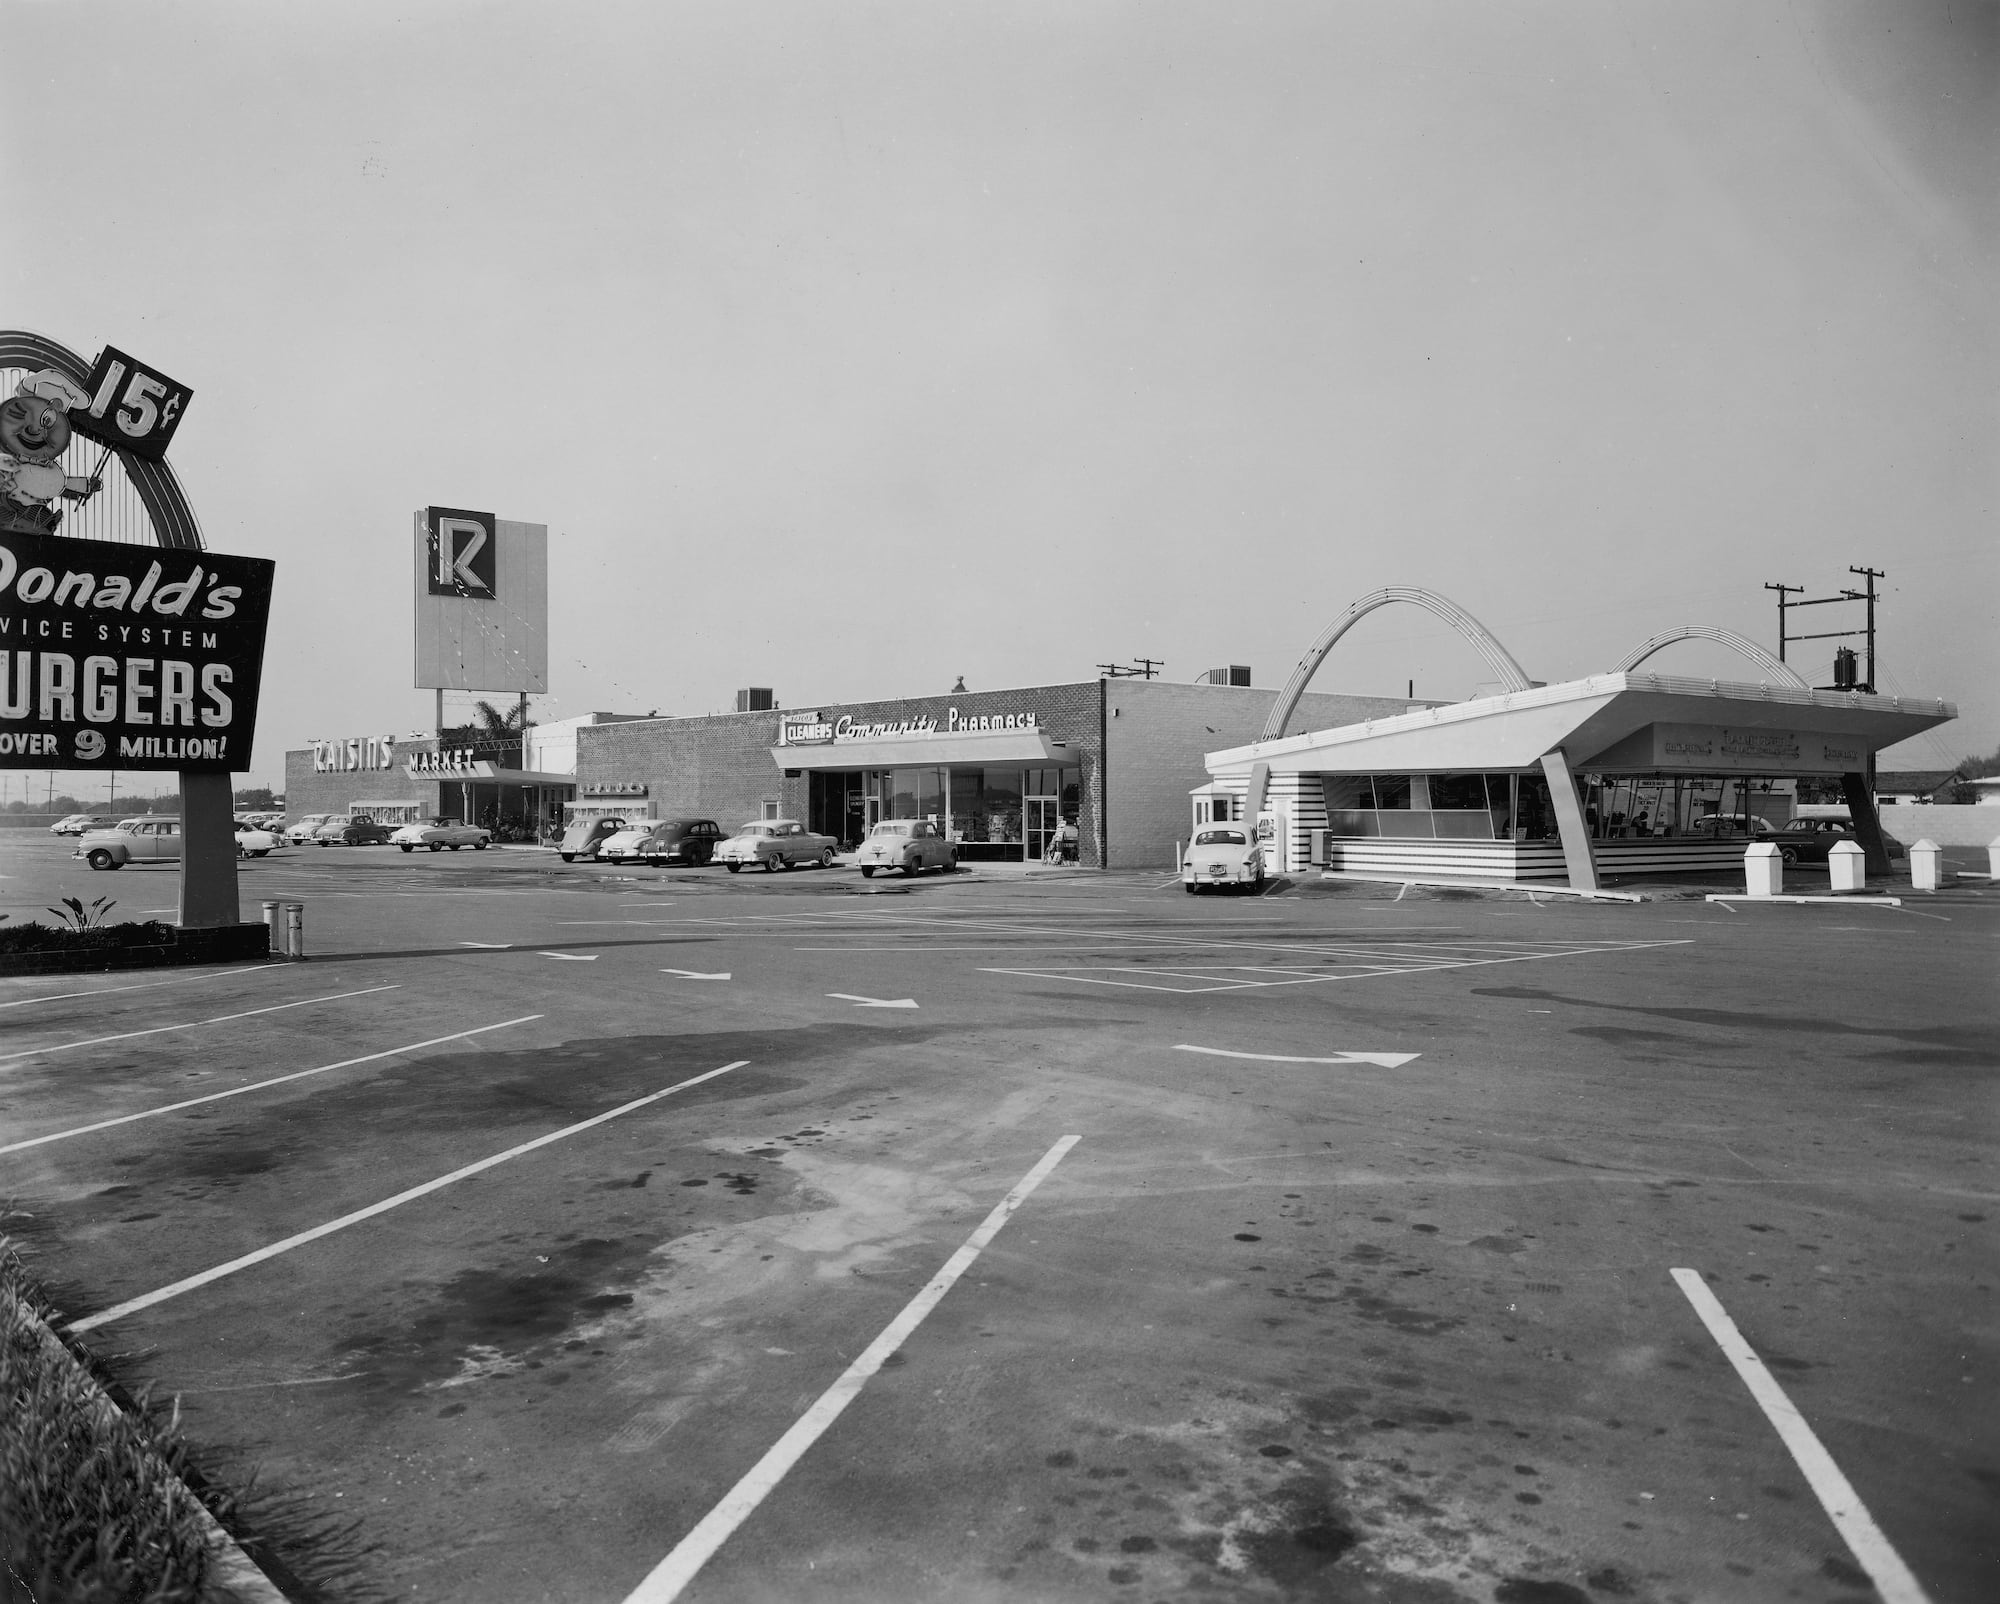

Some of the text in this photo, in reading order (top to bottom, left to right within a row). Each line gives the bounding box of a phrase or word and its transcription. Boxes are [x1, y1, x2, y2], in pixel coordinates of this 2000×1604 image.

[439, 516, 489, 588] R
[99, 625, 217, 649] SYSTEM
[786, 723, 833, 741] CLEANERS
[835, 714, 939, 741] Community
[0, 728, 228, 760] OVER 9 MILLION!
[409, 748, 474, 772] MARKET
[579, 782, 645, 794] LIQUORS
